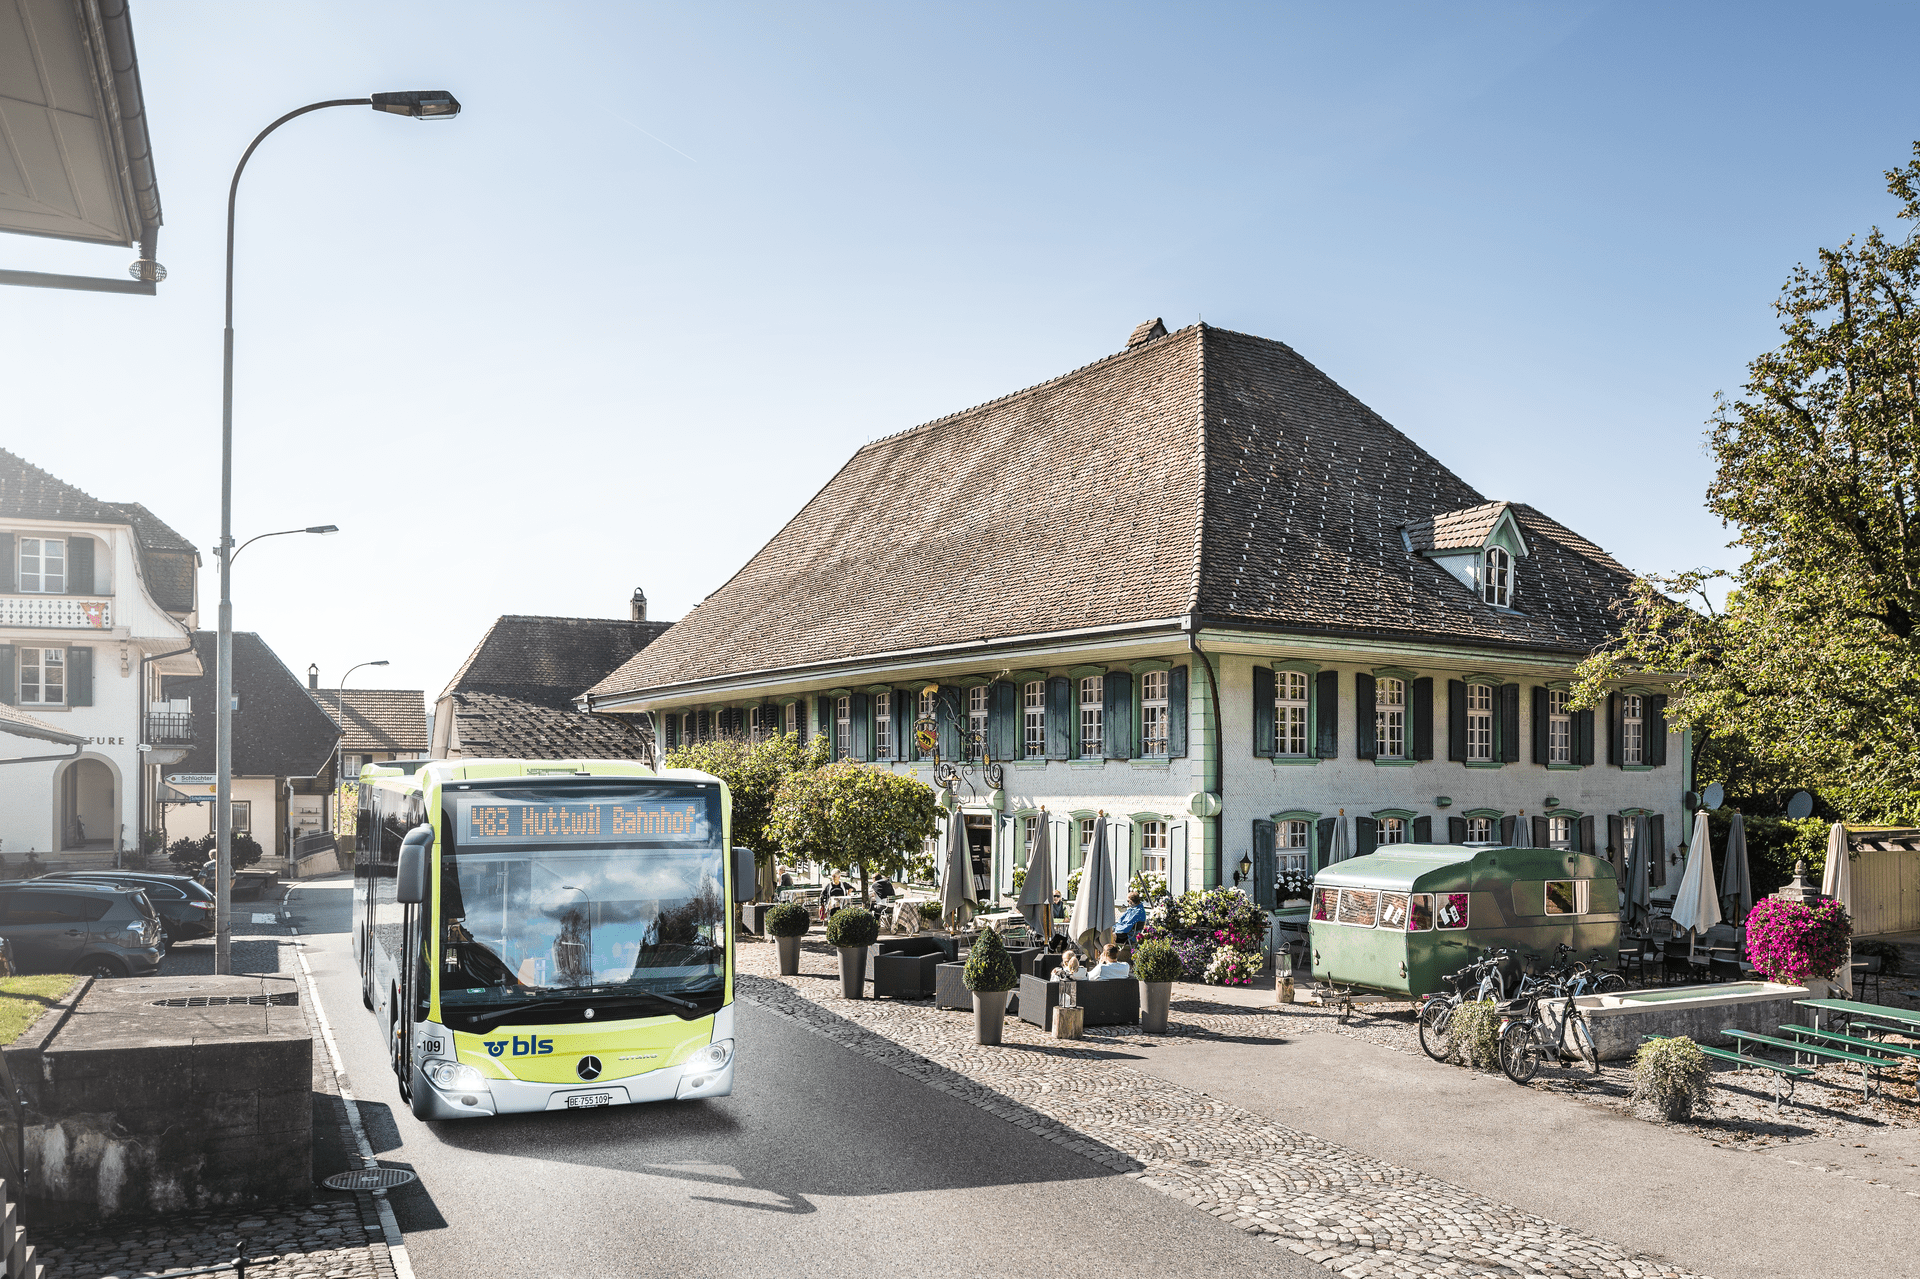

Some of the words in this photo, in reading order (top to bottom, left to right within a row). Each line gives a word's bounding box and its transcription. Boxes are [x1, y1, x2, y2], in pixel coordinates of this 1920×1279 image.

[471, 807, 509, 836] 483
[522, 803, 600, 835] Huttwil
[613, 806, 696, 834] Bahnhof
[422, 1040, 441, 1053] 109
[512, 1035, 554, 1056] bls
